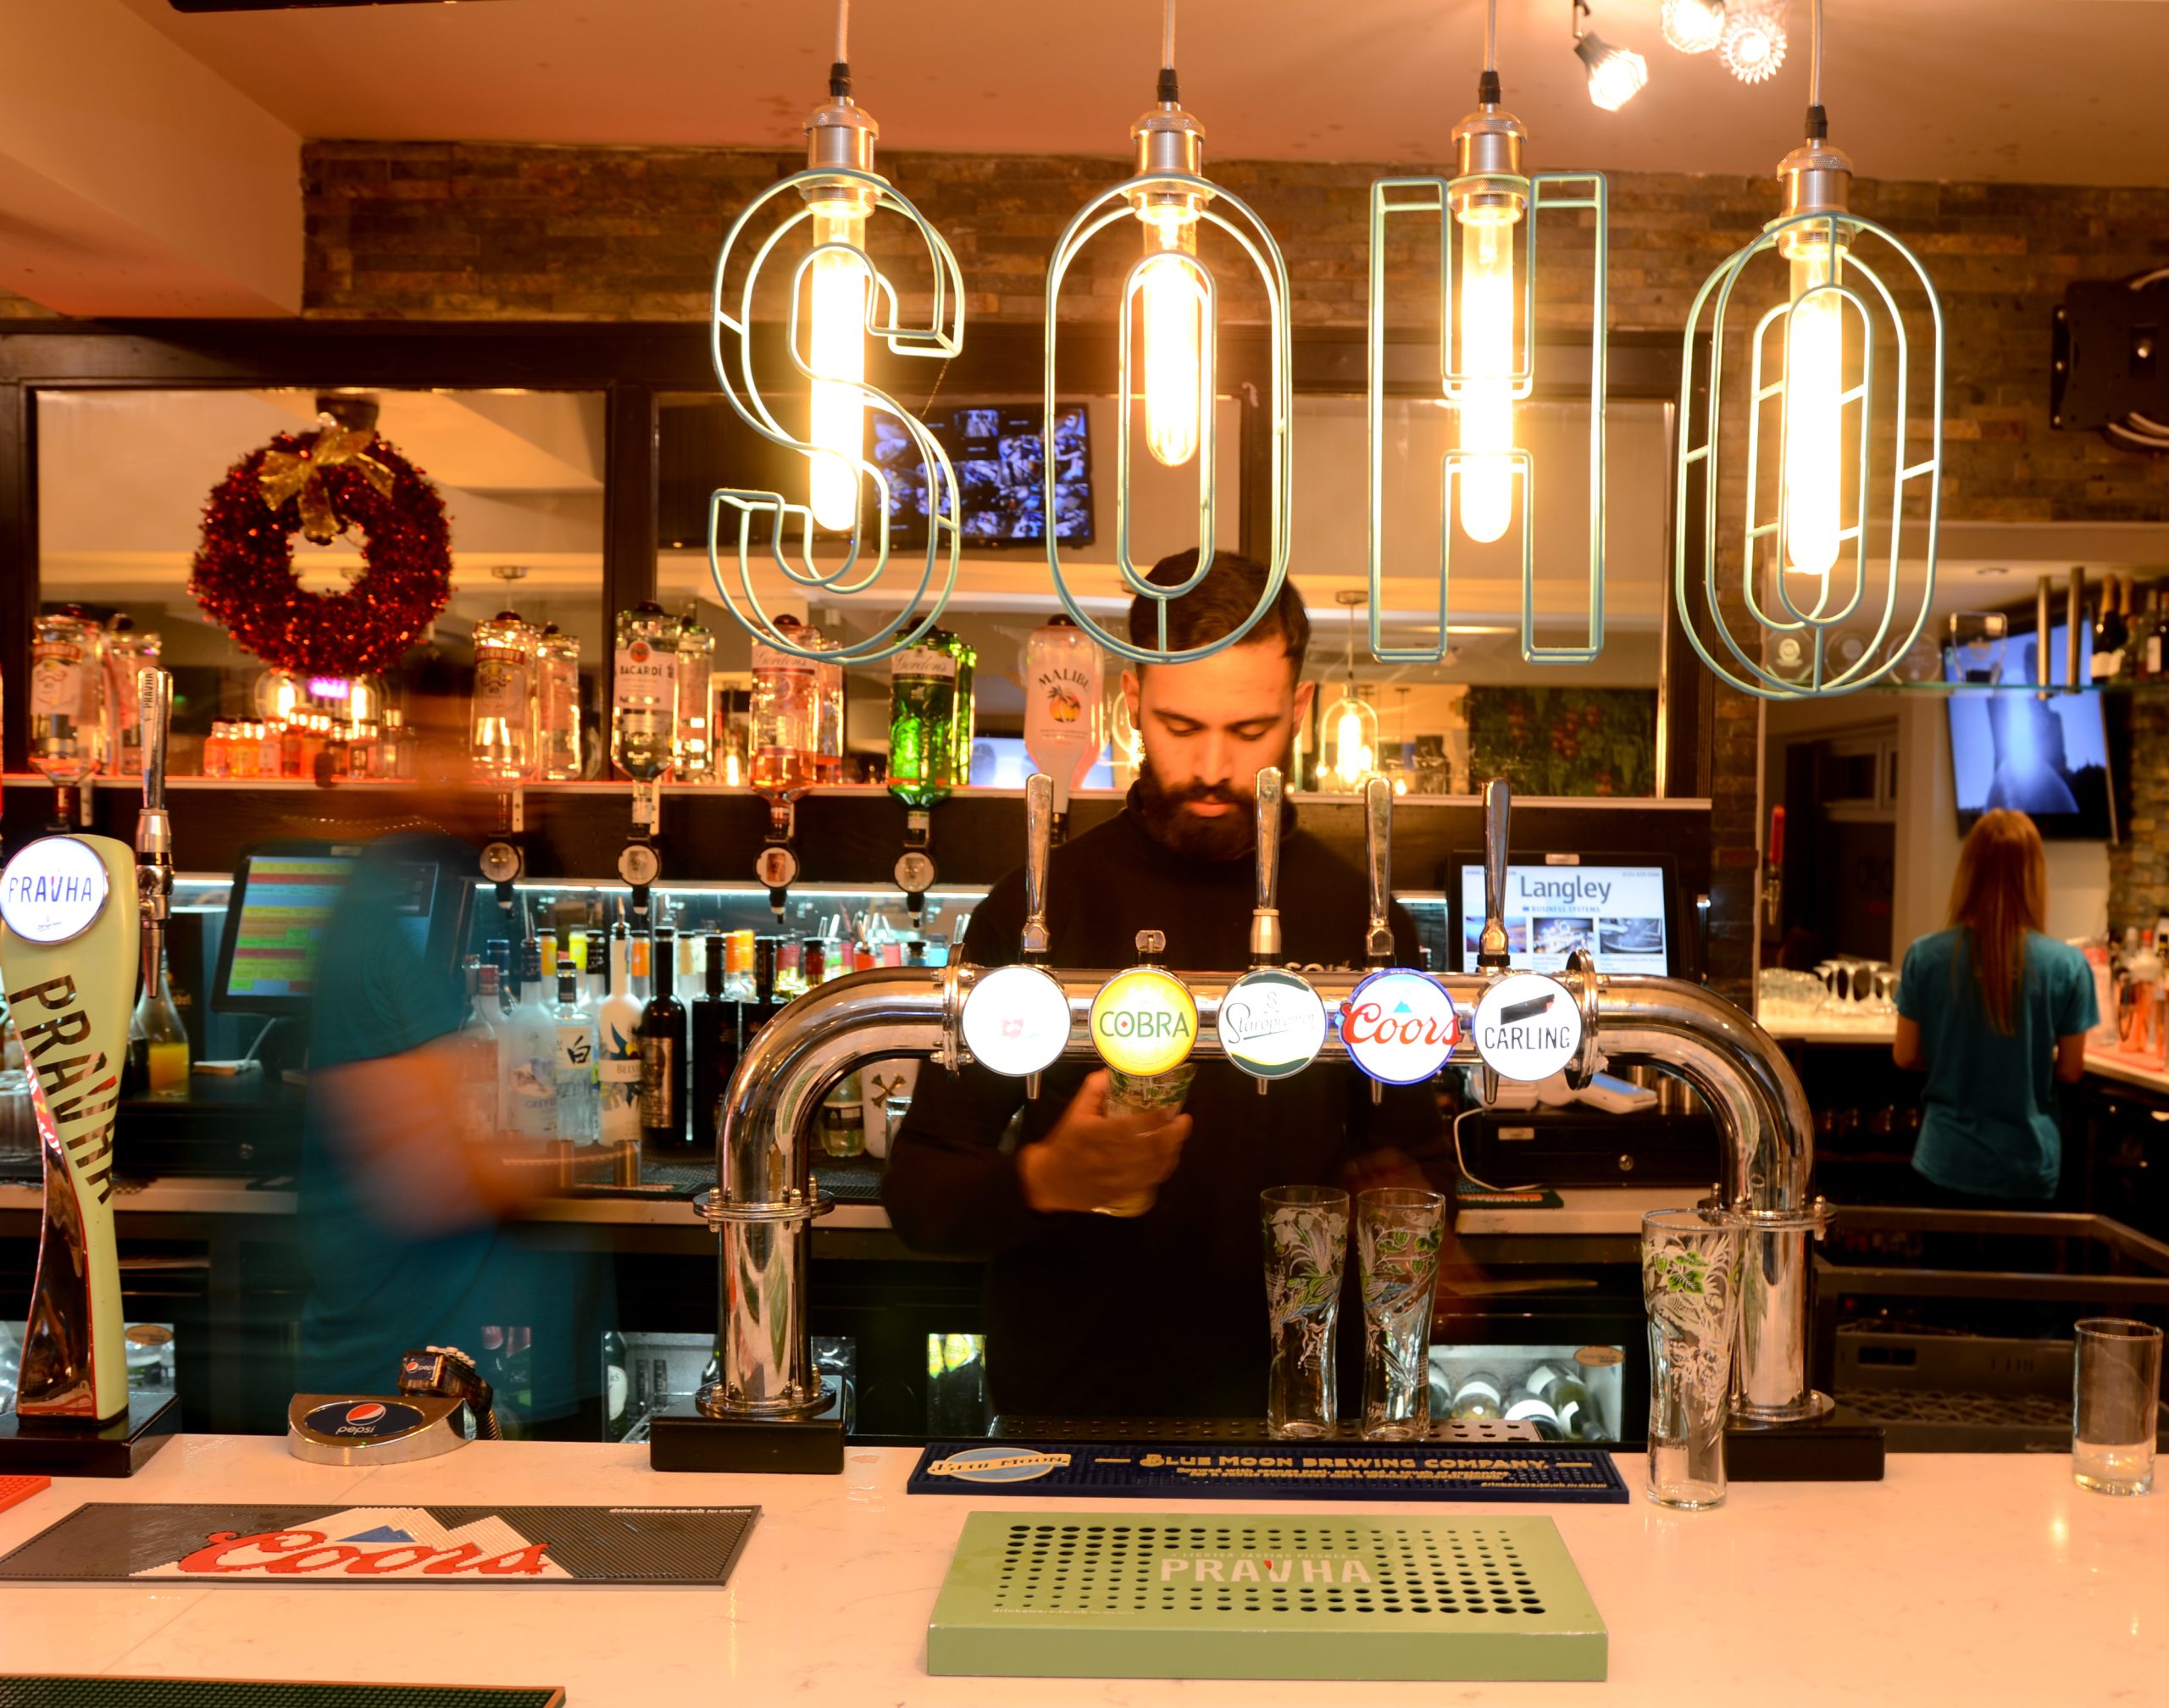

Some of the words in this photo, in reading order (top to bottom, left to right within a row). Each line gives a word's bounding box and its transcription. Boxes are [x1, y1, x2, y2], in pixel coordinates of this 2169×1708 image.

[8, 875, 92, 903] PRAVHA
[1520, 875, 1611, 905] Langley
[1099, 1010, 1190, 1038] COBRA
[1340, 1001, 1466, 1046] Coors
[1484, 1025, 1571, 1050] CARLING
[335, 1425, 374, 1435] pepsi
[1218, 1455, 1293, 1467] MOON
[1302, 1457, 1417, 1469] BREWING
[178, 1529, 550, 1575] Coors
[1160, 1558, 1372, 1583] PRAVHA
